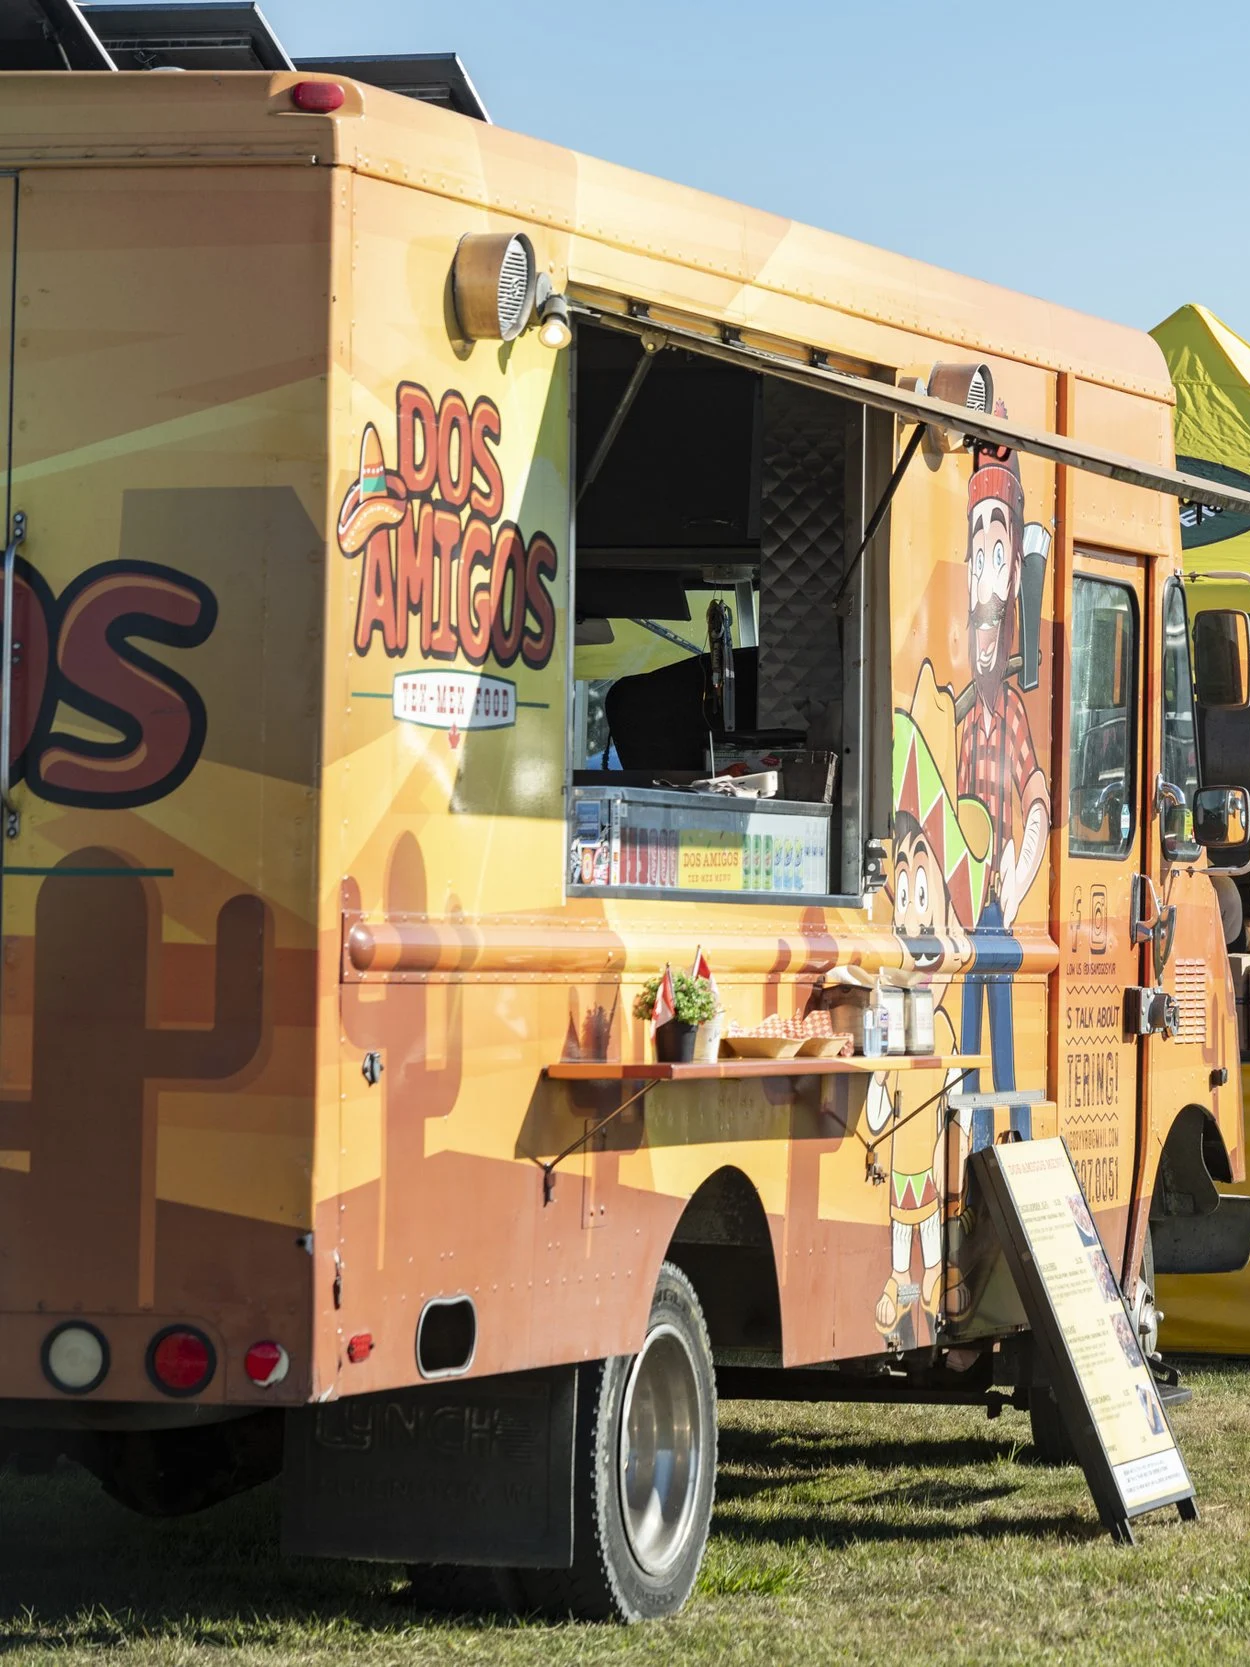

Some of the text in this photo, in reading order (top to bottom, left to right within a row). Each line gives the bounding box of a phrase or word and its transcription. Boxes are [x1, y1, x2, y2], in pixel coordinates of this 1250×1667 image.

[396, 380, 504, 525] DOS
[354, 502, 557, 669] AMIGOS
[403, 683, 509, 717] TEX-MEX FOOD
[683, 852, 738, 867] DOS AMIGOS
[1076, 1006, 1094, 1028] TALK
[1097, 1005, 1120, 1028] ABOUT
[1065, 1051, 1119, 1108] TERING!
